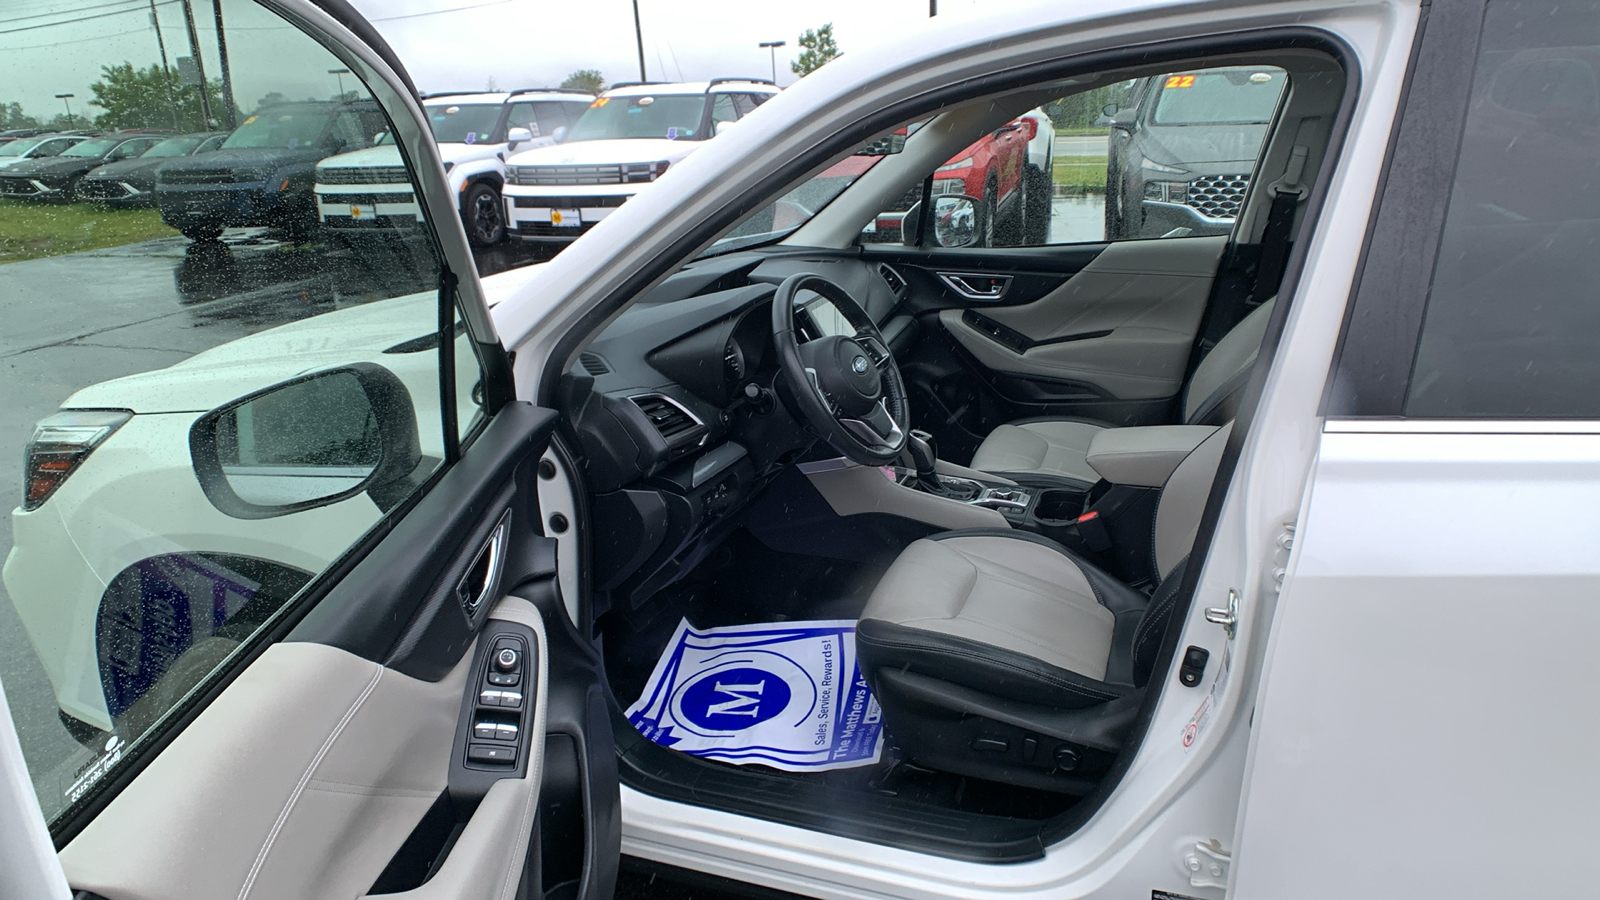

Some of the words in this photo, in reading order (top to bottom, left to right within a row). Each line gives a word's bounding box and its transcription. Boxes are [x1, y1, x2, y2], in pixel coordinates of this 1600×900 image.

[1166, 75, 1195, 88] 22
[821, 640, 833, 686] Rewards!
[706, 679, 765, 719] M
[818, 688, 832, 719] Service,
[841, 689, 866, 738] Matthews
[814, 721, 830, 746] Sales,
[833, 739, 851, 760] The
